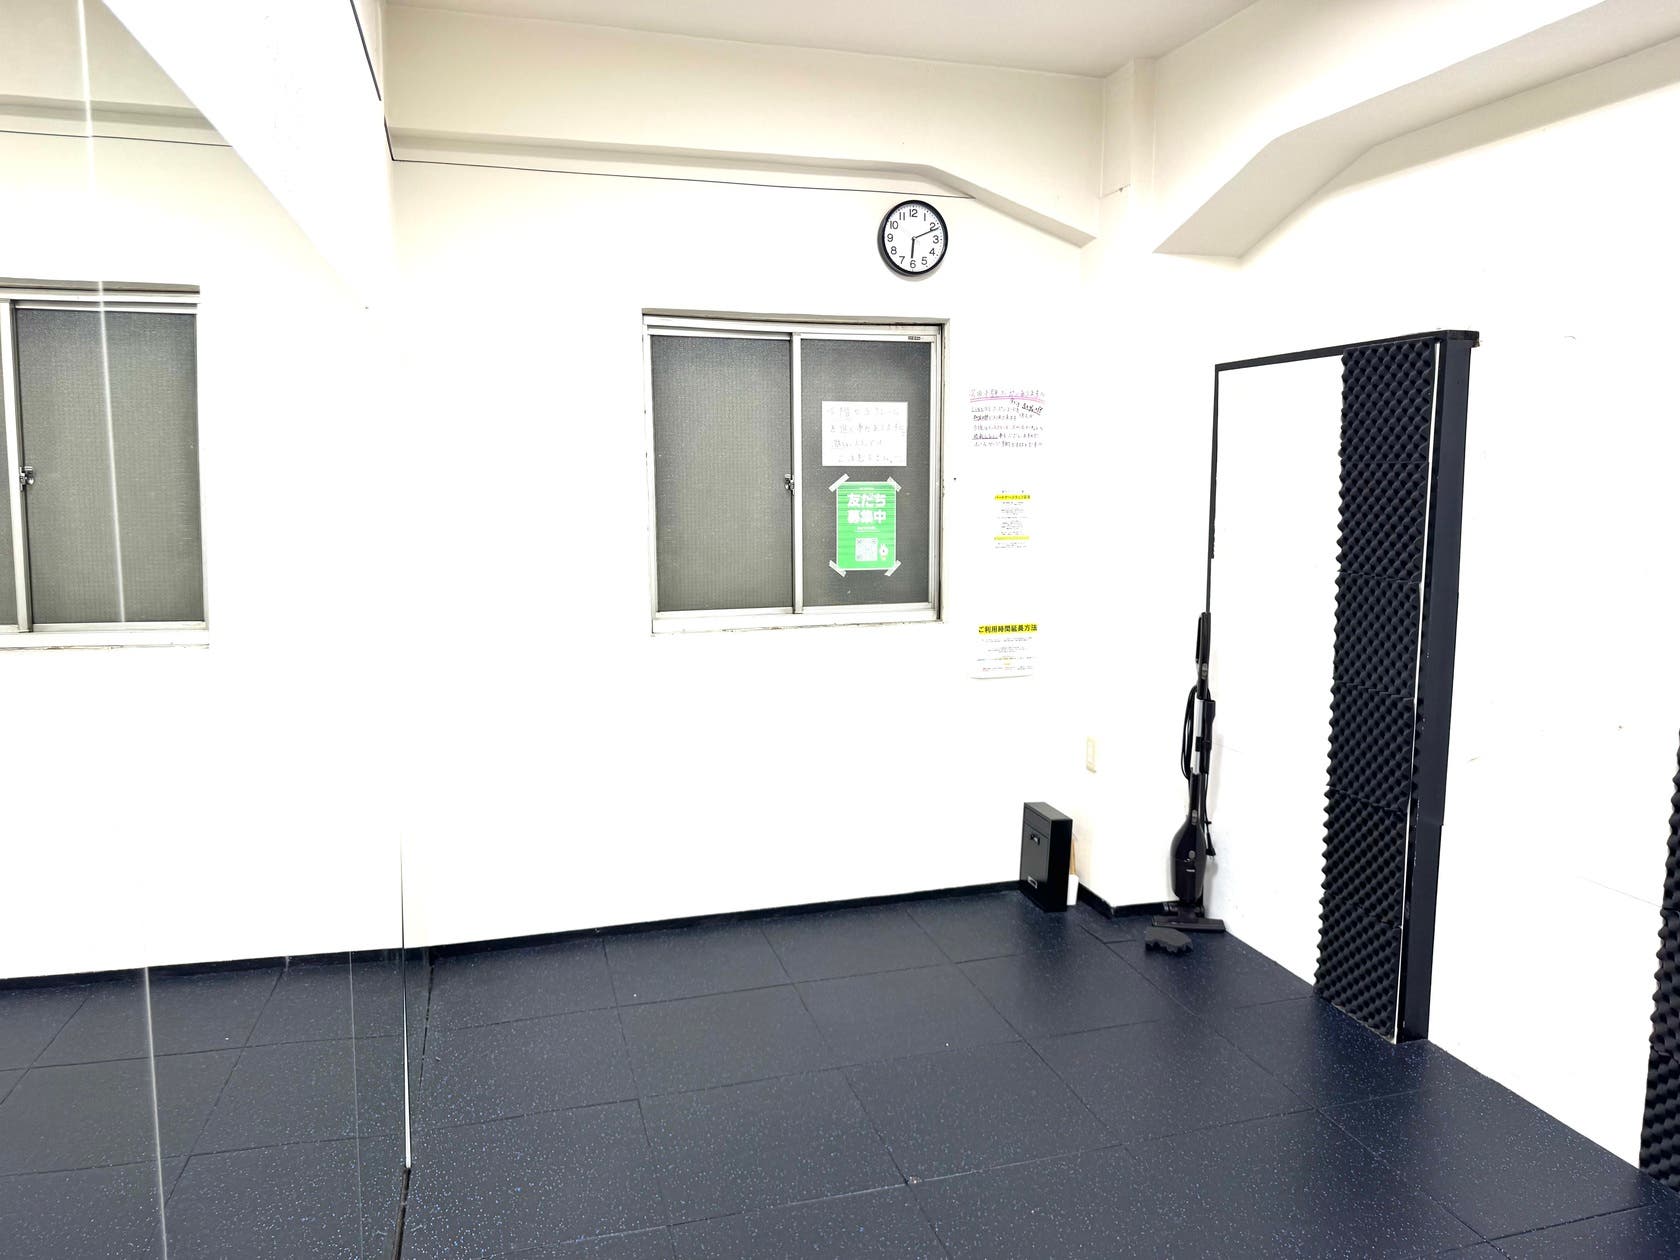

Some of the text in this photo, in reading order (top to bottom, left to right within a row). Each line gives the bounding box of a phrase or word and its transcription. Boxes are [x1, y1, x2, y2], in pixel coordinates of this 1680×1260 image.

[899, 211, 906, 221] 11
[909, 208, 918, 218] 12
[889, 220, 899, 230] 10
[929, 222, 936, 231] 2
[887, 233, 894, 243] 9
[932, 234, 940, 244] 3
[890, 246, 897, 255] 8
[929, 247, 936, 257] 4
[899, 255, 906, 265] 7
[909, 259, 917, 269] 6
[921, 256, 928, 266] 5
[847, 493, 887, 508] 友だち
[847, 509, 887, 524] 募集中
[978, 624, 1038, 634] ご利用時間延長方法
